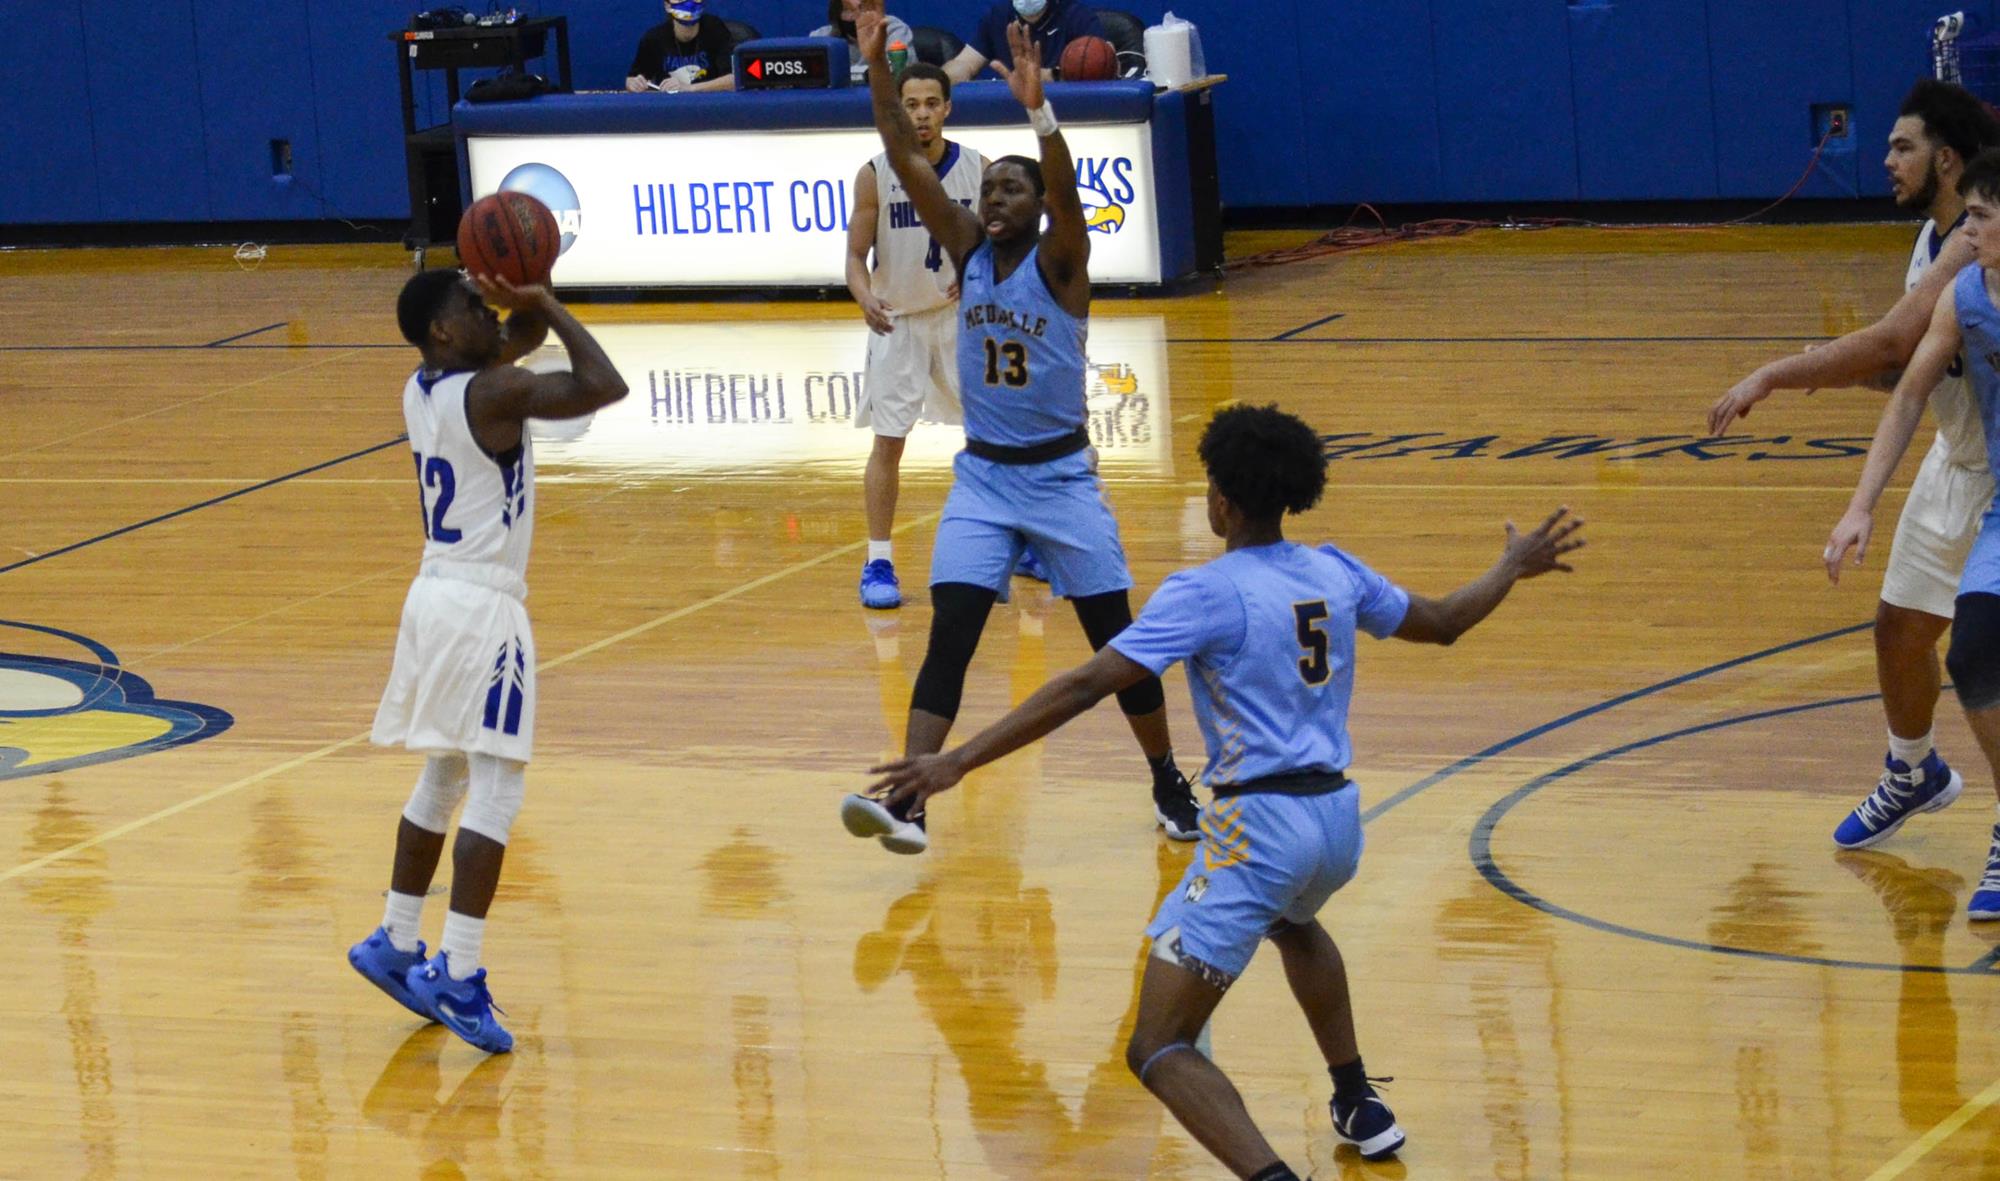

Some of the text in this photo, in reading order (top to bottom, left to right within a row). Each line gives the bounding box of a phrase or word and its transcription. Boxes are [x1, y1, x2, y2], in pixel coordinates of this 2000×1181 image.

[765, 61, 807, 76] POSS.
[633, 181, 774, 235] HILBERT
[924, 234, 943, 273] 4
[984, 337, 1028, 388] 13
[413, 452, 463, 544] 12
[1292, 598, 1331, 688] 5
